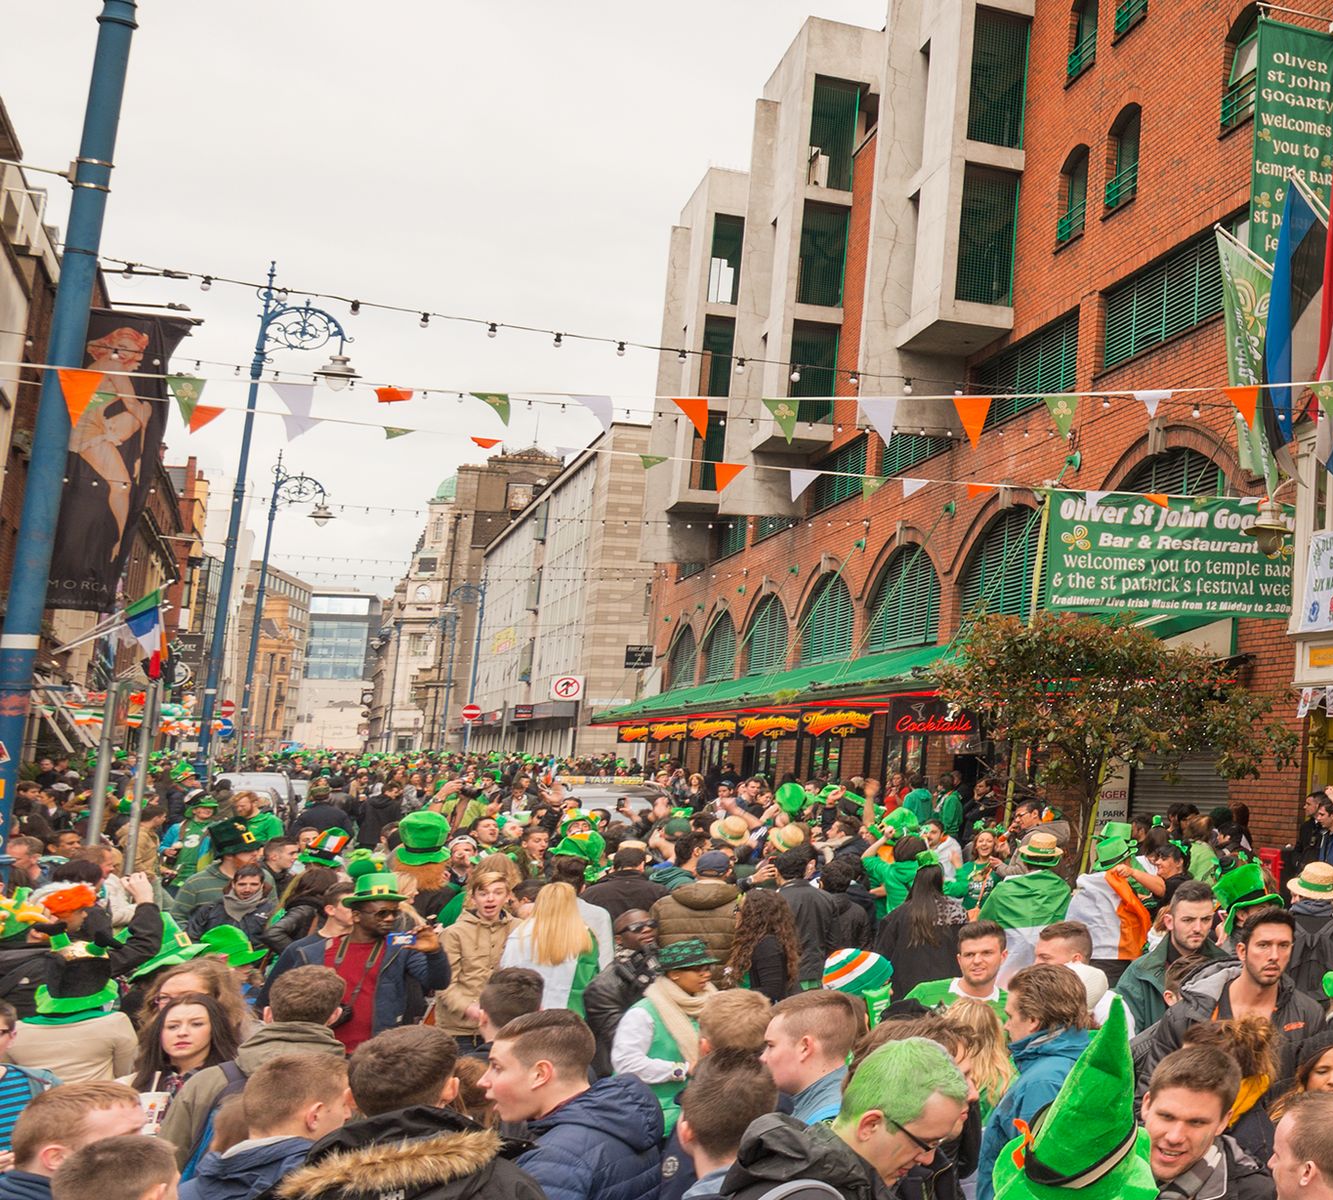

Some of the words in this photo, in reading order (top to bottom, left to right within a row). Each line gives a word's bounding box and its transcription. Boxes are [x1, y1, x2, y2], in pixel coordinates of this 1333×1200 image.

[1273, 139, 1299, 156] you
[1303, 142, 1319, 159] to
[1060, 498, 1128, 524] Oliver
[1130, 504, 1155, 527] St
[1154, 505, 1209, 532] John
[1098, 532, 1131, 550] Bar
[1137, 534, 1153, 550] &
[1157, 535, 1260, 555] Restaurant
[1150, 559, 1180, 579] you
[1184, 558, 1202, 573] to
[1206, 558, 1260, 580] temple
[1052, 571, 1063, 588] &
[1067, 572, 1096, 589] the
[1051, 594, 1105, 606] Traditional
[1106, 595, 1126, 607] Live
[1127, 597, 1150, 608] Irish
[1151, 598, 1180, 610] Music
[1181, 599, 1204, 611] from
[1205, 600, 1217, 611] 12
[1219, 601, 1253, 613] Midday
[1254, 602, 1264, 612] to
[896, 713, 972, 733] Cocktails
[1103, 810, 1125, 818] PARK
